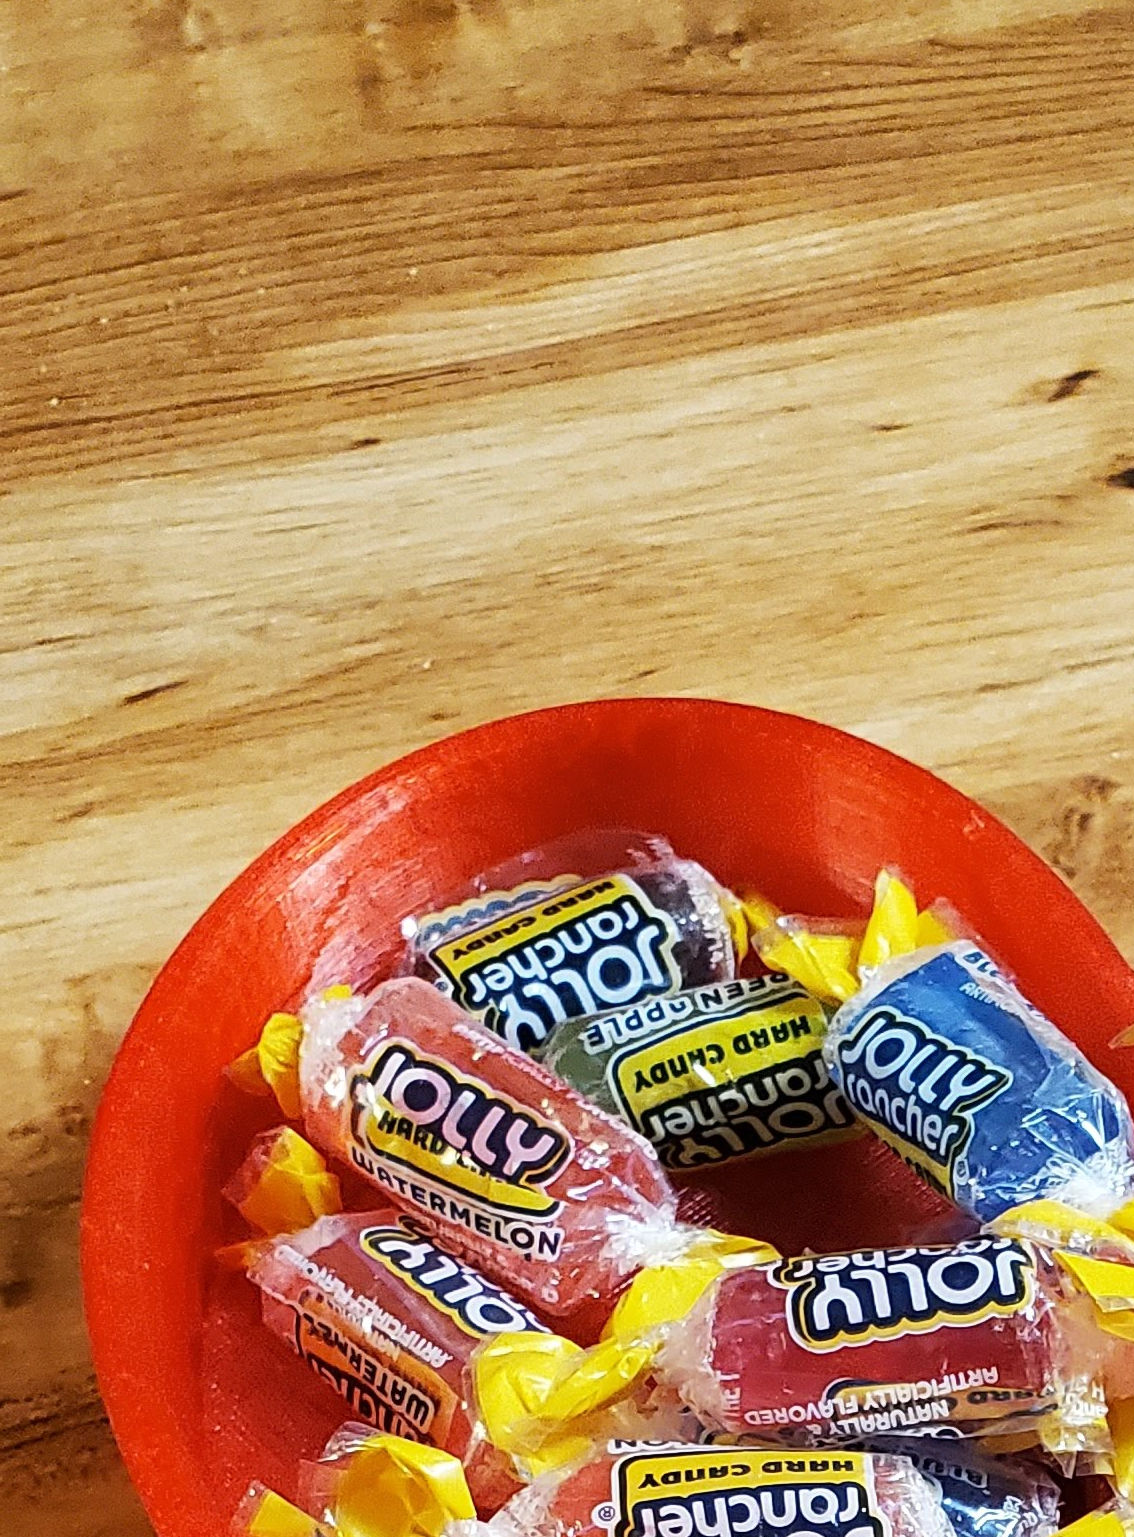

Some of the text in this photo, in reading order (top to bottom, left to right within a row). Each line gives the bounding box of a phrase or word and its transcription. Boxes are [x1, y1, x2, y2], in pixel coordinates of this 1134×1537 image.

[451, 881, 615, 961] HARD CANDY
[466, 902, 642, 996] rancher
[499, 925, 667, 1050] JOLLY
[585, 972, 791, 1049] REEN APPLE
[634, 1015, 812, 1094] HARD CANDY
[842, 1019, 997, 1111] JOLLY
[370, 1050, 558, 1174] JOLLY
[649, 1056, 830, 1145] rancher
[675, 1093, 847, 1165] JOLLY
[847, 1073, 958, 1158] rancher
[352, 1151, 561, 1257] WATERMELON
[814, 1250, 1032, 1330] JOLLY
[302, 1313, 432, 1428] WATERMEL
[743, 1392, 857, 1428] FLAVORED
[832, 1367, 999, 1411] ARTIFICIALLY
[828, 1401, 949, 1434] NATURALLY
[637, 1459, 853, 1488] HARD CANDY
